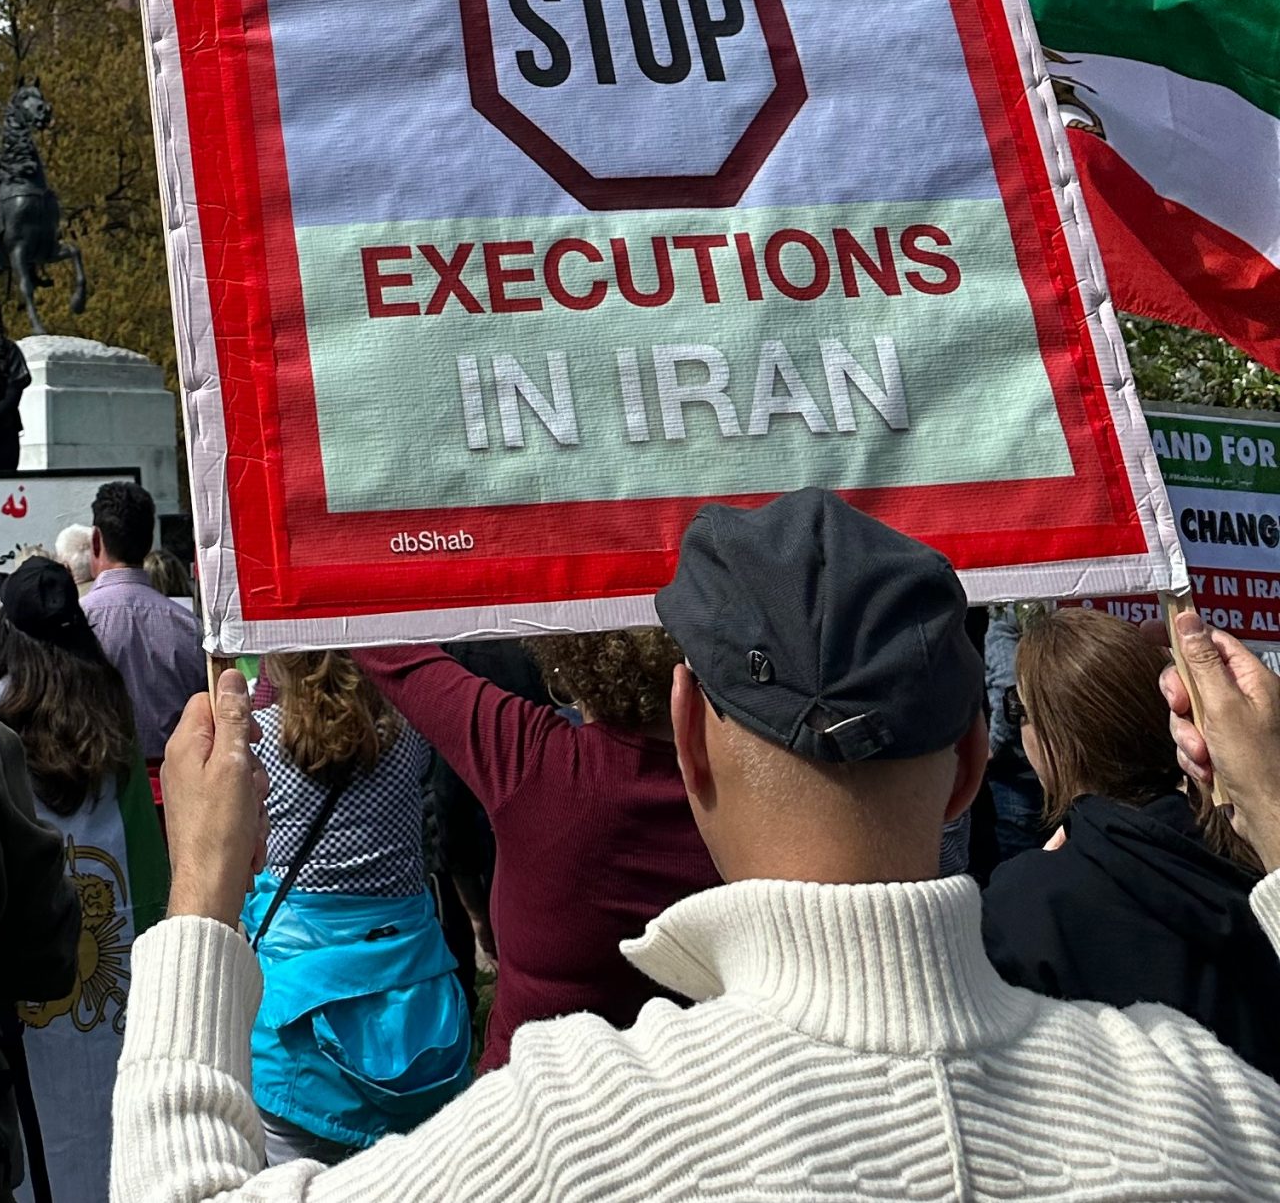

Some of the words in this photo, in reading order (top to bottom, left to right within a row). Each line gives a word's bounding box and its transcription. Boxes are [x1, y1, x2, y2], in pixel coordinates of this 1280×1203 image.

[360, 224, 962, 319] EXECUTIONS
[456, 349, 580, 450] IN
[614, 335, 910, 443] IRAN
[1221, 435, 1278, 468] FOR
[1, 486, 28, 518] نه
[390, 529, 474, 553] dbShab
[1181, 508, 1280, 548] CHANG
[1213, 576, 1239, 596] IN
[1200, 607, 1244, 630] FOR
[1250, 611, 1280, 632] AL
